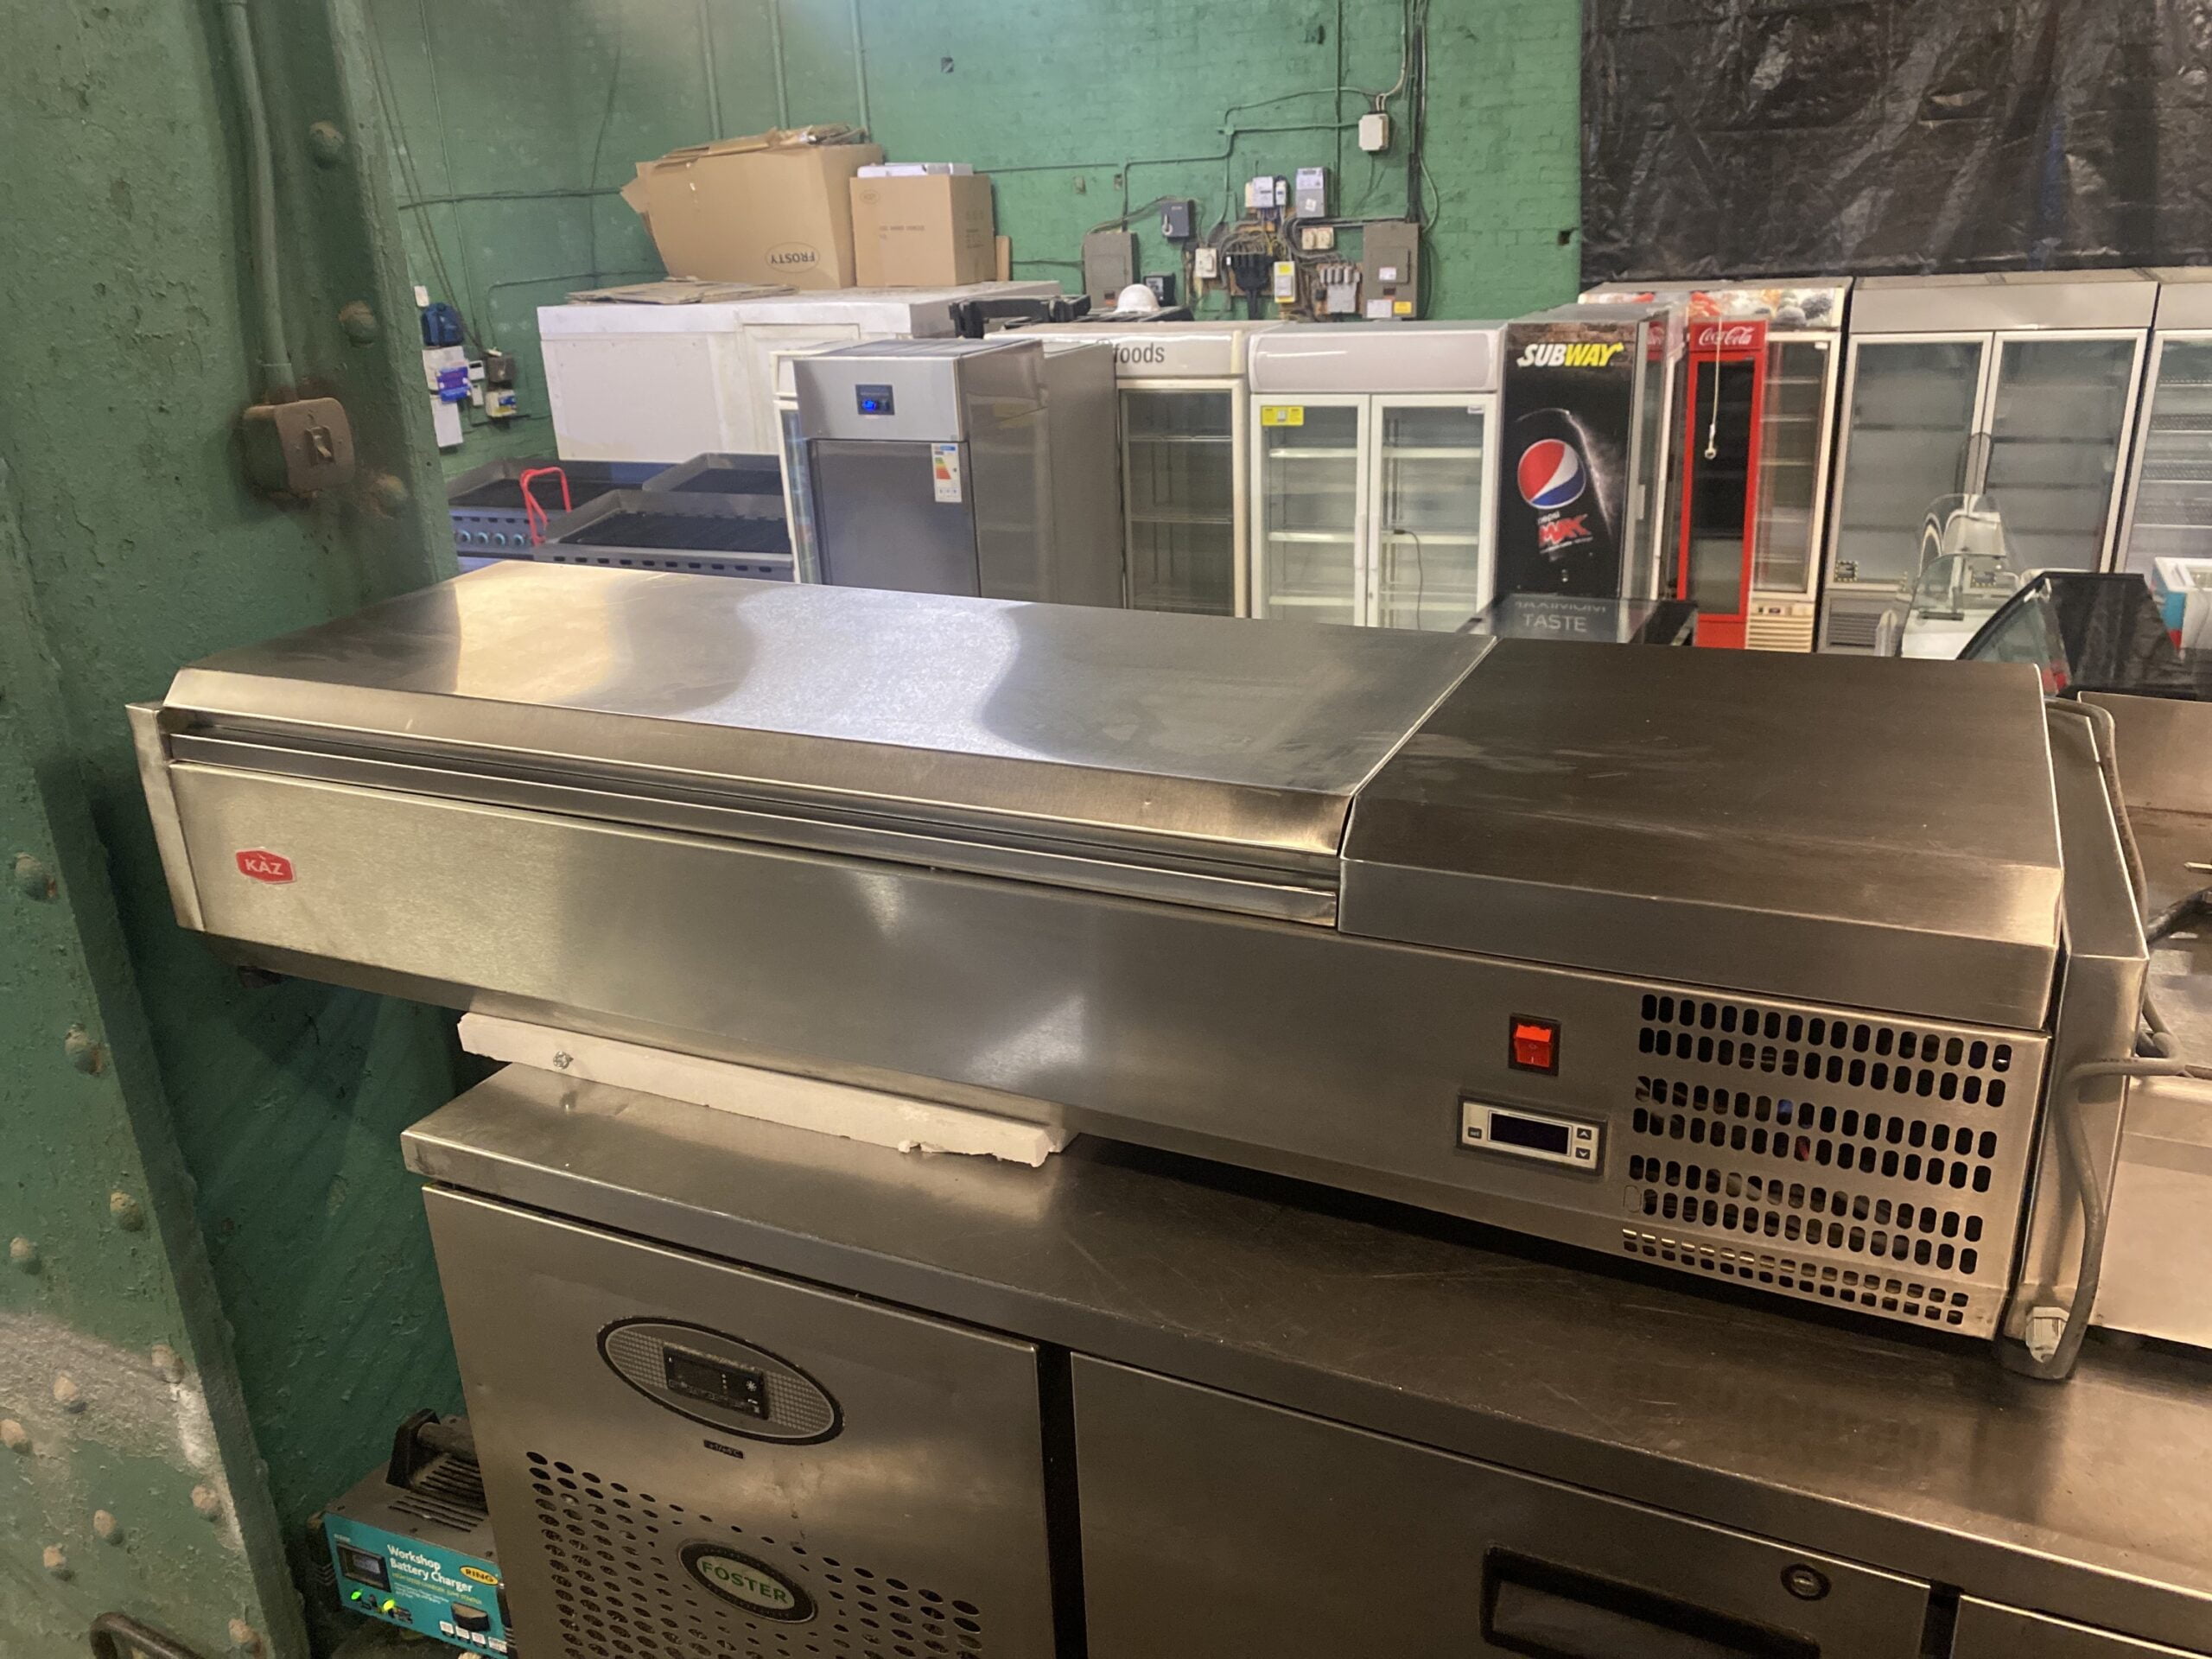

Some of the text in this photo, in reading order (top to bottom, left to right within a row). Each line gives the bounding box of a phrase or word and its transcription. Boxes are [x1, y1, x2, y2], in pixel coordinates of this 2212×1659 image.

[771, 251, 815, 264] FROSTY
[1113, 342, 1165, 364] foods
[1516, 341, 1624, 367] SUBWAY
[1522, 613, 1587, 632] TASTE
[387, 1544, 442, 1571] Workshop
[390, 1558, 429, 1580] Battery
[430, 1569, 474, 1592] Charger
[463, 1568, 494, 1583] RING
[701, 1560, 788, 1605] FOSTER
